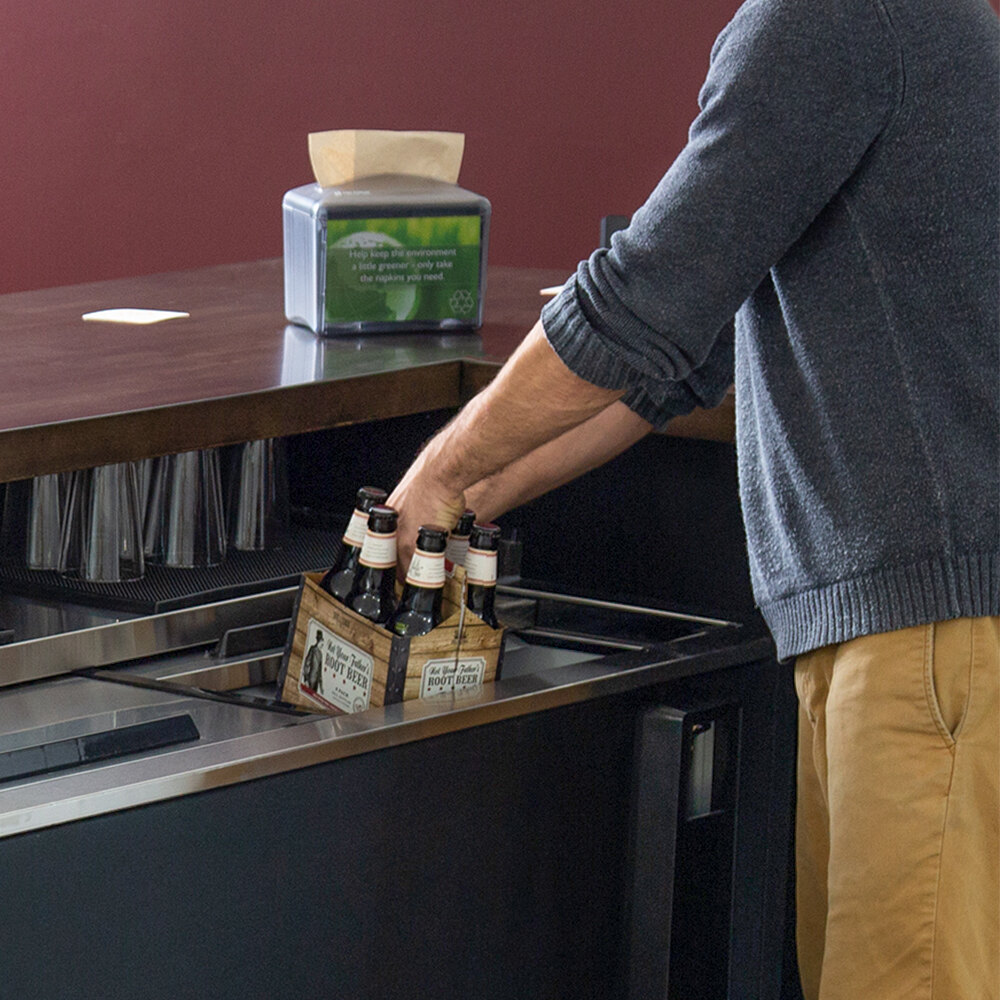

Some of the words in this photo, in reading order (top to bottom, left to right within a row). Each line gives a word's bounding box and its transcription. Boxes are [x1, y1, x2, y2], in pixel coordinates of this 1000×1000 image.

[350, 250, 368, 260] Help
[370, 250, 389, 260] keep
[391, 249, 404, 257] the
[407, 249, 456, 257] environment
[359, 262, 376, 270] little
[378, 262, 409, 271] greener
[417, 260, 434, 271] only
[436, 260, 453, 268] take
[360, 274, 373, 282] the
[375, 273, 405, 283] napkins
[407, 274, 422, 282] you
[325, 653, 346, 675] ROOT
[347, 666, 369, 690] BEER
[428, 675, 453, 687] ROOT
[456, 674, 478, 685] BEER
